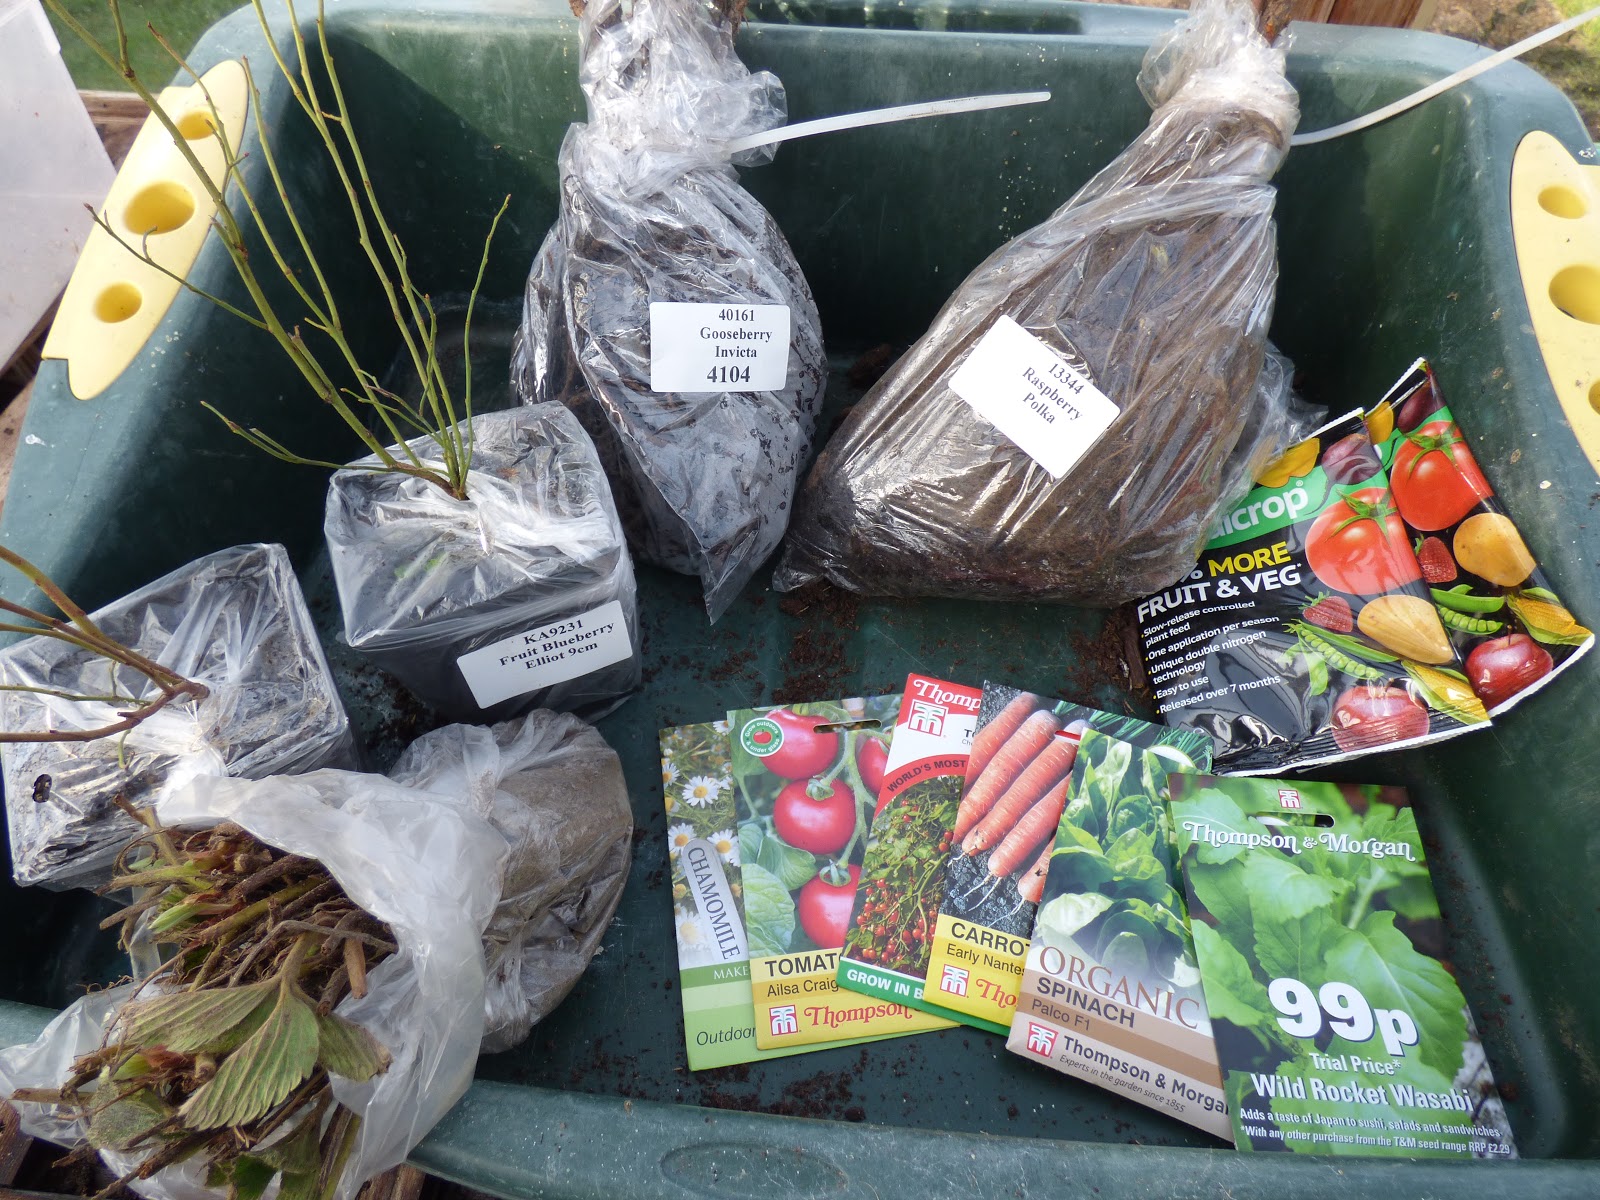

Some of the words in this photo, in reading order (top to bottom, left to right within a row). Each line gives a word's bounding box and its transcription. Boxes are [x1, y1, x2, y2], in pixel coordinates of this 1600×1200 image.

[719, 308, 755, 321] 40161
[700, 326, 772, 343] Gooseberry
[715, 346, 757, 358] Invicta
[706, 365, 751, 383] 4104
[1048, 363, 1085, 395] 13344
[1022, 366, 1083, 421] Raspberry
[1022, 392, 1056, 424] Polka
[1207, 541, 1292, 577] MORE
[1137, 581, 1211, 624] FRUIT
[1216, 579, 1240, 599] &
[523, 619, 584, 645] KA9231
[1143, 608, 1200, 637] Slow-release
[1203, 601, 1255, 614] controlled
[499, 647, 538, 666] Fruit
[542, 622, 614, 652] Blueberry
[1145, 633, 1168, 649] plant
[1169, 622, 1191, 638] feed
[1148, 647, 1166, 660] One
[1168, 628, 1220, 653] application
[1223, 622, 1240, 635] per
[1242, 616, 1280, 628] season
[525, 652, 565, 670] Elliot
[568, 642, 598, 656] 9cm
[1151, 656, 1184, 674] Unique
[1185, 643, 1220, 662] double
[1221, 631, 1266, 650] nitrogen
[1153, 660, 1206, 685] technology
[1156, 686, 1177, 699] Easy
[1178, 681, 1189, 691] to
[1191, 676, 1209, 687] use
[1159, 693, 1204, 714] Released
[1205, 685, 1228, 698] over
[1230, 684, 1237, 693] 7
[1239, 674, 1281, 691] months
[887, 763, 932, 793] WORLD'S
[934, 760, 966, 768] MOST
[1183, 820, 1302, 854] Thompson
[1302, 836, 1318, 849] &
[1319, 832, 1416, 862] Morgan
[687, 847, 741, 960] CHAMOMILE
[947, 943, 979, 965] Early
[951, 922, 1030, 956] CARRO
[765, 953, 841, 977] TOMAT
[767, 983, 800, 997] Ailsa
[803, 979, 839, 993] Craig
[847, 969, 891, 991] GROW
[894, 982, 910, 996] IN
[1040, 946, 1199, 1030] ORGANIC
[804, 1003, 913, 1029] Thompson
[1032, 998, 1070, 1023] Palco
[1074, 1014, 1091, 1031] F1
[1037, 977, 1135, 1028] SPINACH
[1267, 977, 1419, 1056] 99p
[1064, 1035, 1150, 1082] Thompson
[1155, 1073, 1166, 1089] &
[1309, 1052, 1348, 1073] Trial
[1059, 1054, 1089, 1072] Experts
[1090, 1066, 1099, 1076] in
[1099, 1070, 1114, 1082] the
[1114, 1075, 1143, 1093] garden
[1144, 1088, 1165, 1103] since
[1166, 1098, 1186, 1113] 1855
[1250, 1073, 1307, 1100] Wild
[1310, 1077, 1389, 1106] Rocket
[1389, 1083, 1474, 1112] Wasabi
[1240, 1108, 1265, 1121] Adds
[1267, 1113, 1274, 1121] a
[1275, 1113, 1300, 1123] taste
[1302, 1113, 1313, 1123] of
[1314, 1113, 1346, 1128] Japan
[1347, 1118, 1357, 1127] to
[1358, 1118, 1388, 1131] sushi,
[1389, 1120, 1421, 1131] salads
[1423, 1122, 1442, 1133] and
[1269, 1129, 1285, 1140] any
[1287, 1130, 1311, 1140] other
[1313, 1132, 1354, 1144] purchase
[1356, 1134, 1376, 1145] from
[1378, 1135, 1392, 1146] the
[1393, 1136, 1416, 1148] T&M
[1418, 1140, 1440, 1150] seed
[1441, 1142, 1467, 1153] range
[1469, 1141, 1486, 1153] RRP
[1488, 1144, 1511, 1155] £2.29
